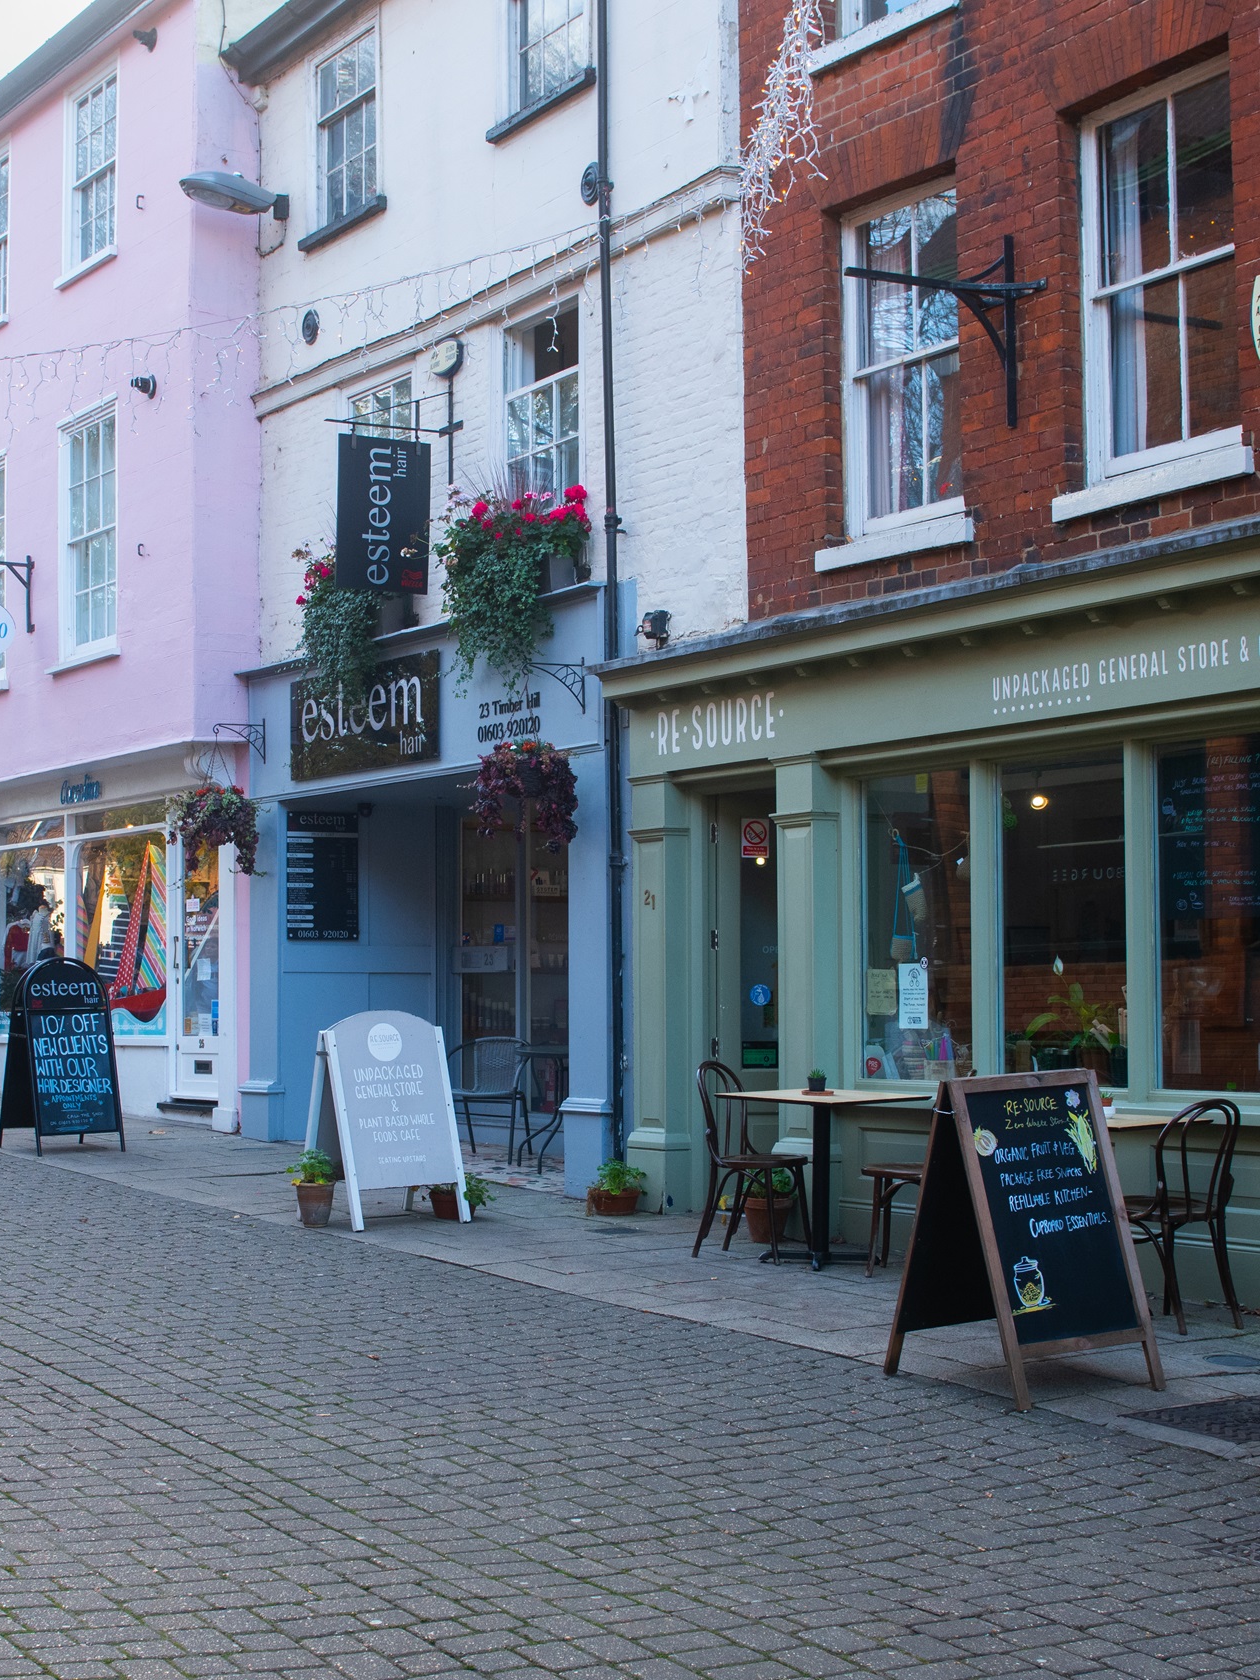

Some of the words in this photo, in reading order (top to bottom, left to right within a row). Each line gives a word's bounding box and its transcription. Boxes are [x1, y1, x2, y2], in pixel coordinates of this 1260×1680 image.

[393, 447, 407, 478] hair
[361, 446, 392, 585] esteem
[992, 662, 1090, 702] UNPACKAGED
[1098, 649, 1169, 686] GENERAL
[1177, 638, 1230, 673] STORE
[1239, 635, 1250, 663] &
[478, 702, 490, 719] 23
[492, 699, 524, 716] Timber
[526, 691, 541, 710] Hill
[477, 722, 504, 743] 01603
[506, 715, 541, 739] 920120
[299, 812, 346, 826] esteem
[643, 889, 656, 911] 21
[297, 930, 319, 939] 01603
[323, 930, 349, 939] 920120
[30, 979, 99, 998] esteem
[83, 995, 100, 1004] hair
[40, 1014, 66, 1035] 10%
[71, 1013, 100, 1033] OFF
[32, 1036, 58, 1058] NEW
[59, 1034, 109, 1055] CLIENTS
[35, 1058, 65, 1078] WITH
[67, 1057, 99, 1078] OUR
[353, 1063, 424, 1083] UNPACKAGED
[37, 1078, 60, 1094] HAIR
[60, 1077, 113, 1095] DESIGNER
[354, 1082, 393, 1100] GENERAL
[394, 1080, 424, 1097] STORE
[62, 1102, 82, 1110] ONLY
[391, 1098, 400, 1113] &
[359, 1116, 383, 1130] PLANT
[385, 1114, 409, 1128] BASED
[410, 1112, 436, 1126] WHOLE
[373, 1129, 398, 1144] FOODS
[400, 1128, 421, 1142] CAFE
[378, 1156, 402, 1165] SEATING
[994, 1145, 1029, 1165] ORGANIC
[1031, 1140, 1051, 1159] FRUIT
[1059, 1141, 1075, 1156] VEG
[999, 1172, 1034, 1188] PACKAGE
[1036, 1168, 1054, 1182] FREE
[1055, 1166, 1083, 1180] SNACKS
[1008, 1192, 1051, 1213] REFILLABLE
[1029, 1217, 1064, 1238] CUPBOARD
